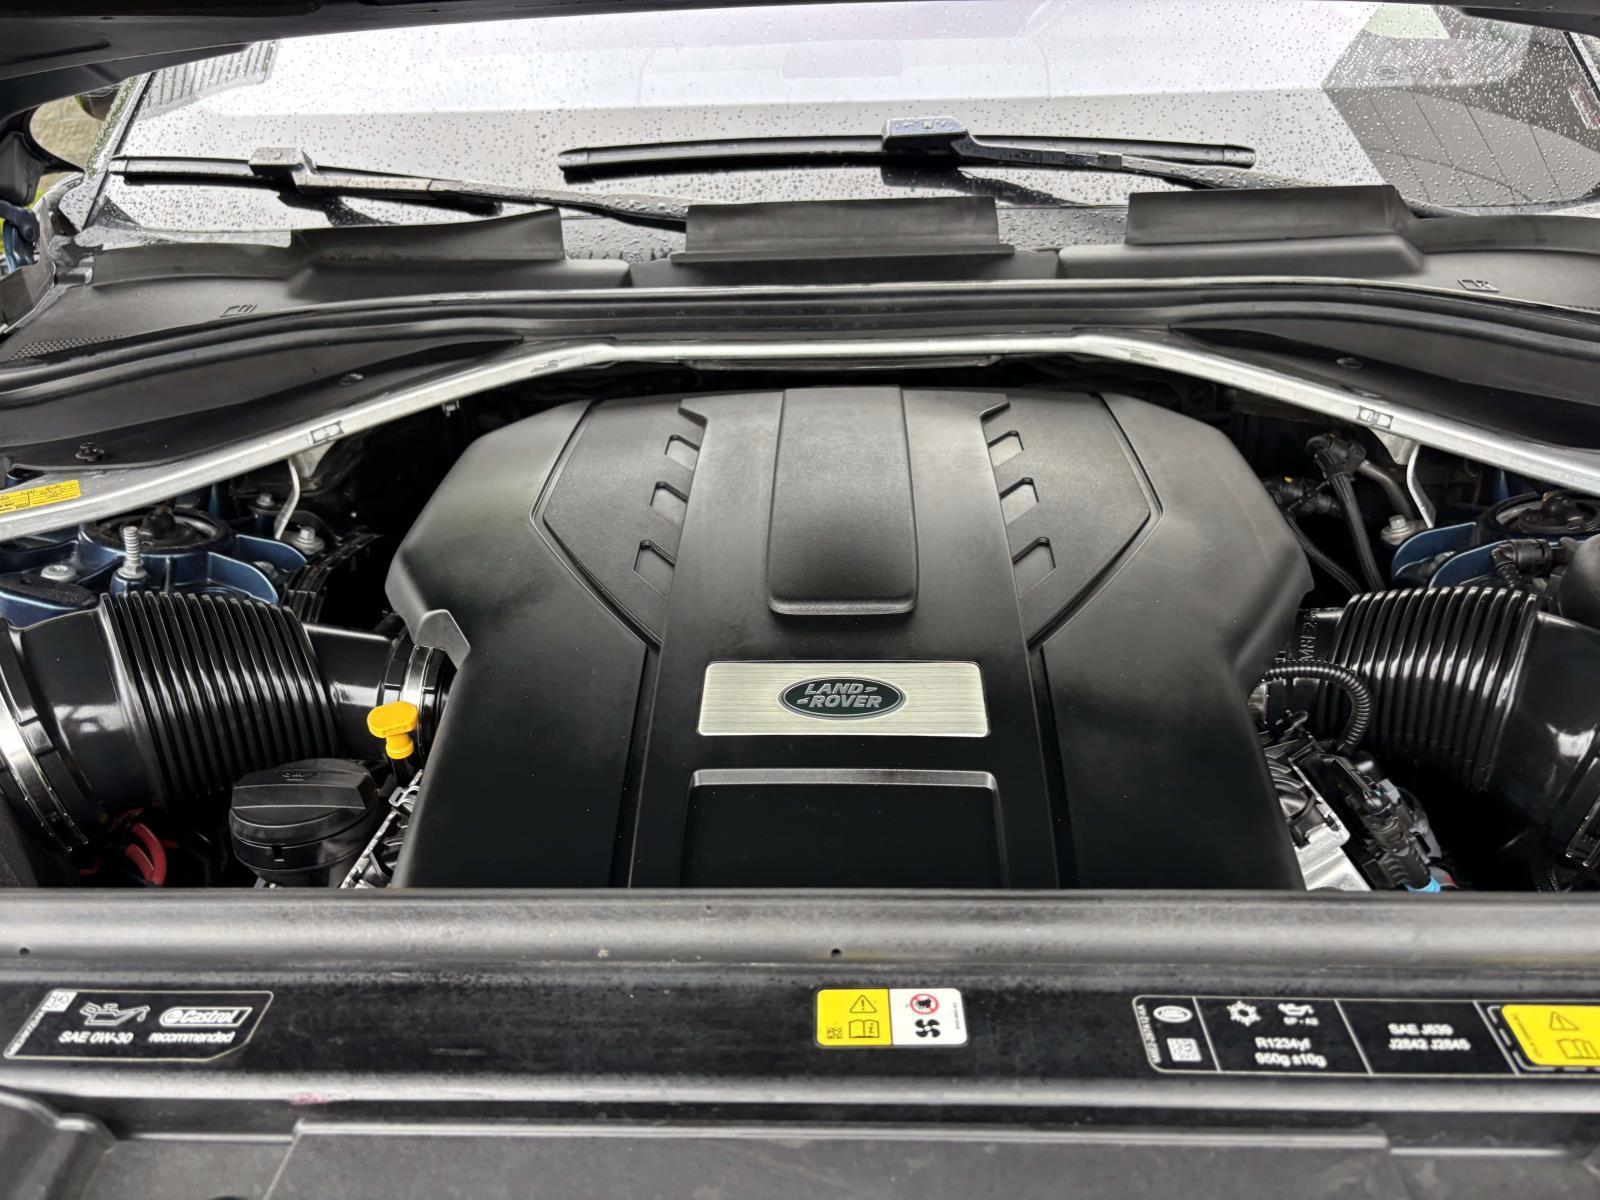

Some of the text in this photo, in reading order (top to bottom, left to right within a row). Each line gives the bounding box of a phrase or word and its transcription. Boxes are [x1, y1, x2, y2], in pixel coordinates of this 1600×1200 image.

[804, 683, 865, 696] LAND
[808, 695, 883, 708] ROVER
[179, 1009, 241, 1024] Castrol
[1387, 1022, 1420, 1036] SAE
[58, 1030, 90, 1044] SAE
[148, 1030, 236, 1044] recommended
[1255, 1036, 1312, 1052] R1234yf
